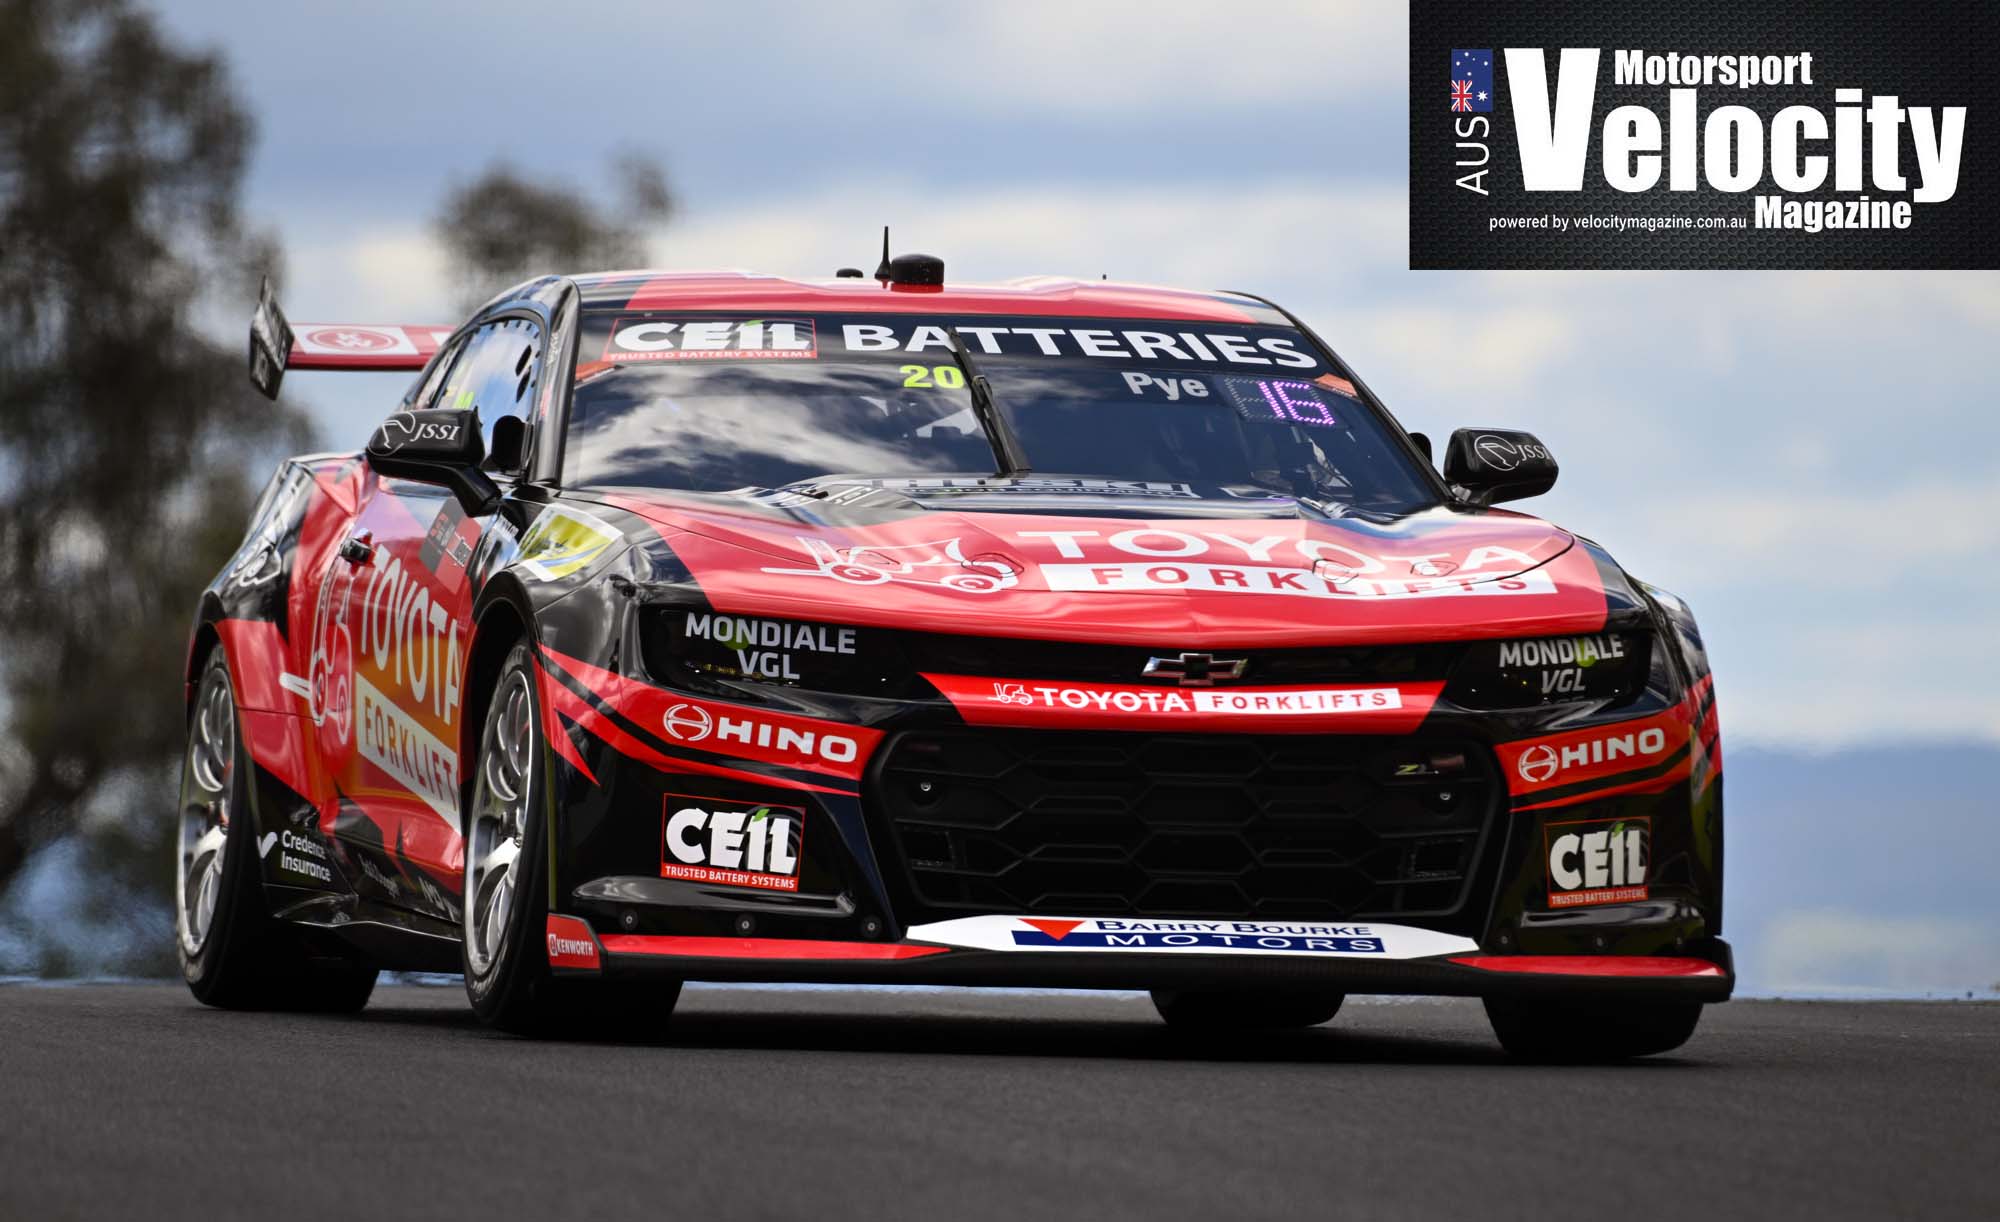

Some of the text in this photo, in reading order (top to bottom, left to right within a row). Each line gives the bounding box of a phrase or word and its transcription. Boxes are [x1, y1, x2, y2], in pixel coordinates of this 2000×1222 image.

[609, 350, 812, 360] TRUSTED BATTERY SYSTEMS
[614, 320, 1317, 369] CEIL BATTERIES
[900, 365, 965, 389] 20
[1121, 371, 1209, 401] Pye
[1258, 381, 1335, 425] 16
[413, 423, 462, 442] JSSI
[1517, 444, 1552, 461] JSSI
[1016, 529, 1538, 576] TOYOTA
[1096, 563, 1527, 597] FORKLIFTS
[361, 544, 460, 727] TOYOTA
[686, 612, 856, 655] MONDIALE
[737, 649, 801, 680] VGL
[1499, 634, 1625, 669] MONDIALE
[1541, 667, 1586, 694] VGL
[1034, 687, 1388, 713] TOYOTA FORKLIFTS
[364, 696, 460, 812] FORKLIFT
[717, 717, 857, 763] HINO
[1562, 728, 1666, 769] HINO
[666, 808, 798, 874] CEIL
[1550, 823, 1648, 891] CEIL
[281, 850, 332, 882] Insurance
[665, 865, 795, 889] TRUSTED BATTERY SYSTEMS
[1551, 893, 1584, 904] TRUSTED
[1585, 891, 1615, 902] BATTERY
[557, 938, 593, 957] KENWORTH
[1104, 934, 1378, 951] MOTORS
